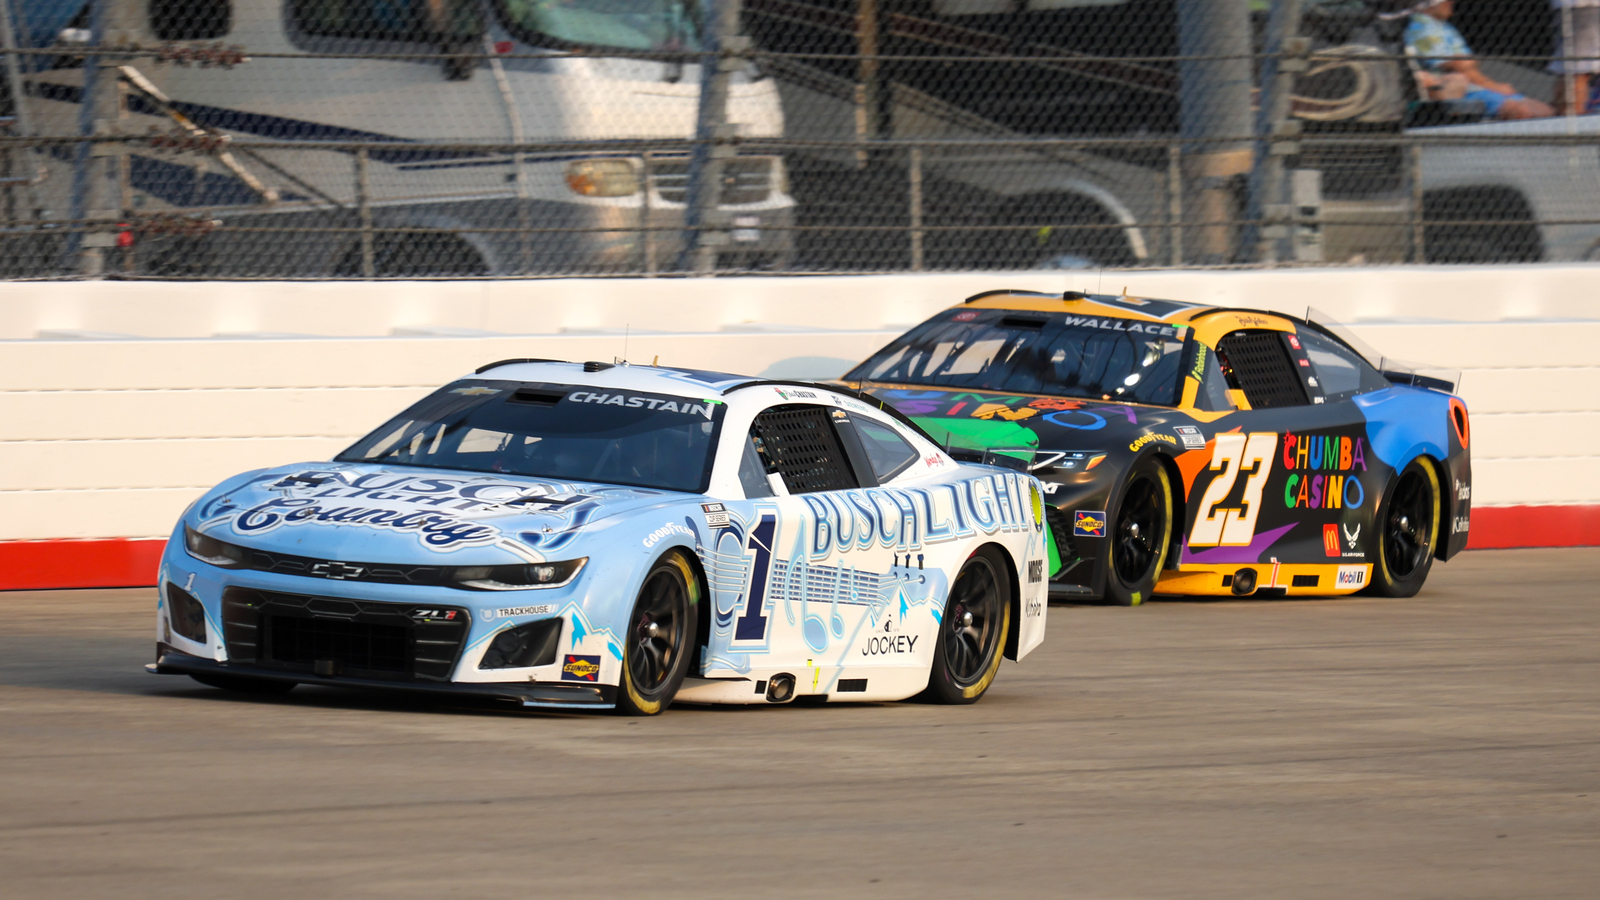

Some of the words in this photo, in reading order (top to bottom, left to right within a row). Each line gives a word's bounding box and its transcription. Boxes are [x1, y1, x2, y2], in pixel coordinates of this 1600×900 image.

[1065, 317, 1175, 337] WALLACE
[568, 391, 714, 420] CHASTAIN
[1129, 432, 1177, 452] GOODYEAR
[1283, 431, 1367, 472] CHUMBA
[312, 487, 484, 511] LIGHT
[1187, 432, 1278, 546] 23
[1284, 474, 1365, 510] CASINO
[237, 499, 493, 546] Country
[643, 522, 696, 548] GOODYEAR
[184, 572, 196, 592] 1
[1339, 571, 1357, 583] Mobil
[412, 609, 458, 620] ZL1
[499, 605, 549, 617] TRACKHOUSE
[862, 635, 919, 657] JOCKEY
[565, 664, 599, 672] SUNOCO
